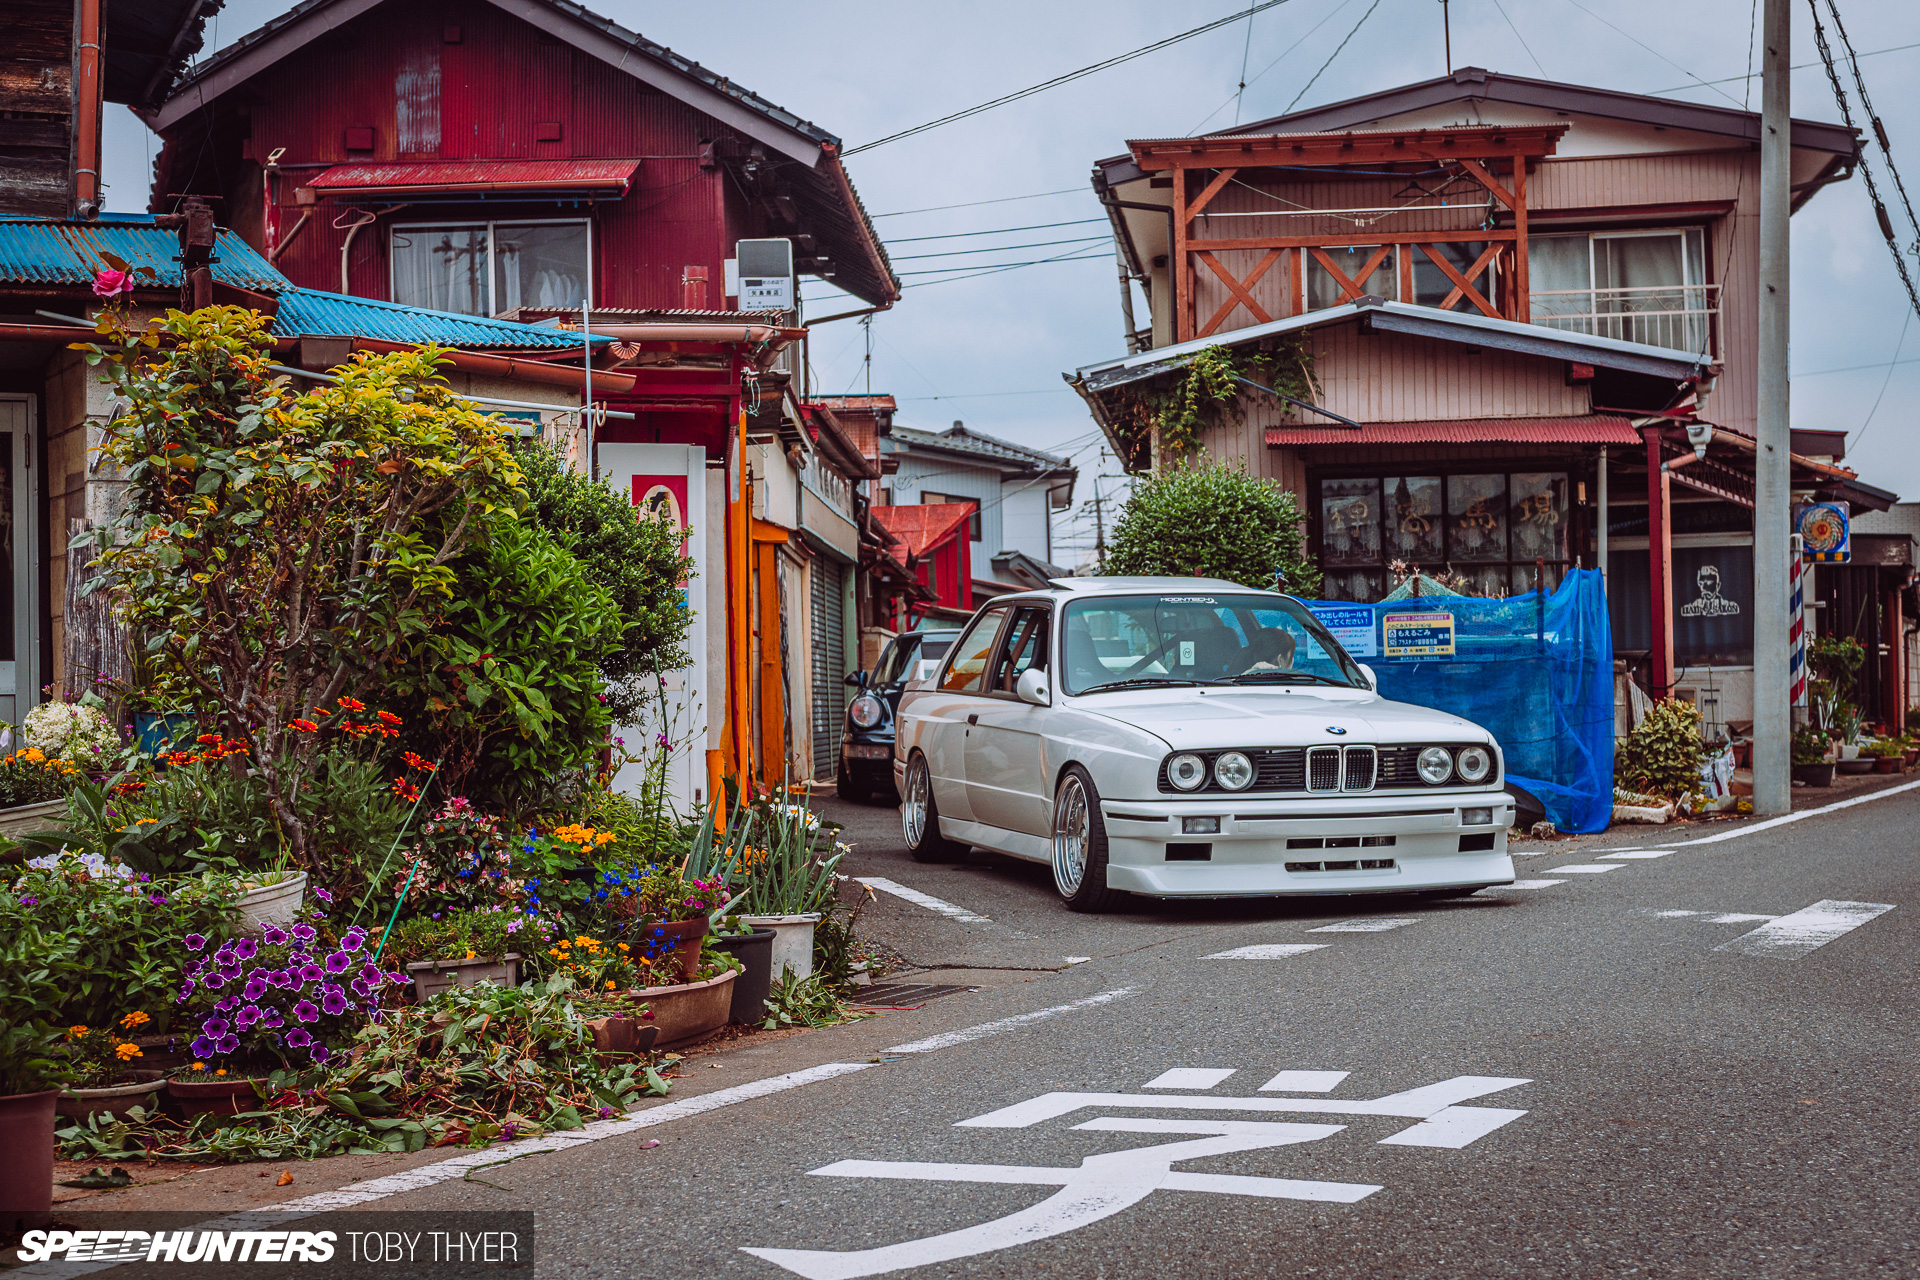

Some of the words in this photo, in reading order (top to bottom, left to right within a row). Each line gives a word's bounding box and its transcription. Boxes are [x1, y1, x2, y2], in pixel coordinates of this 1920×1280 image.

[1319, 618, 1368, 626] 守してください！
[1398, 629, 1431, 637] もえるごみ
